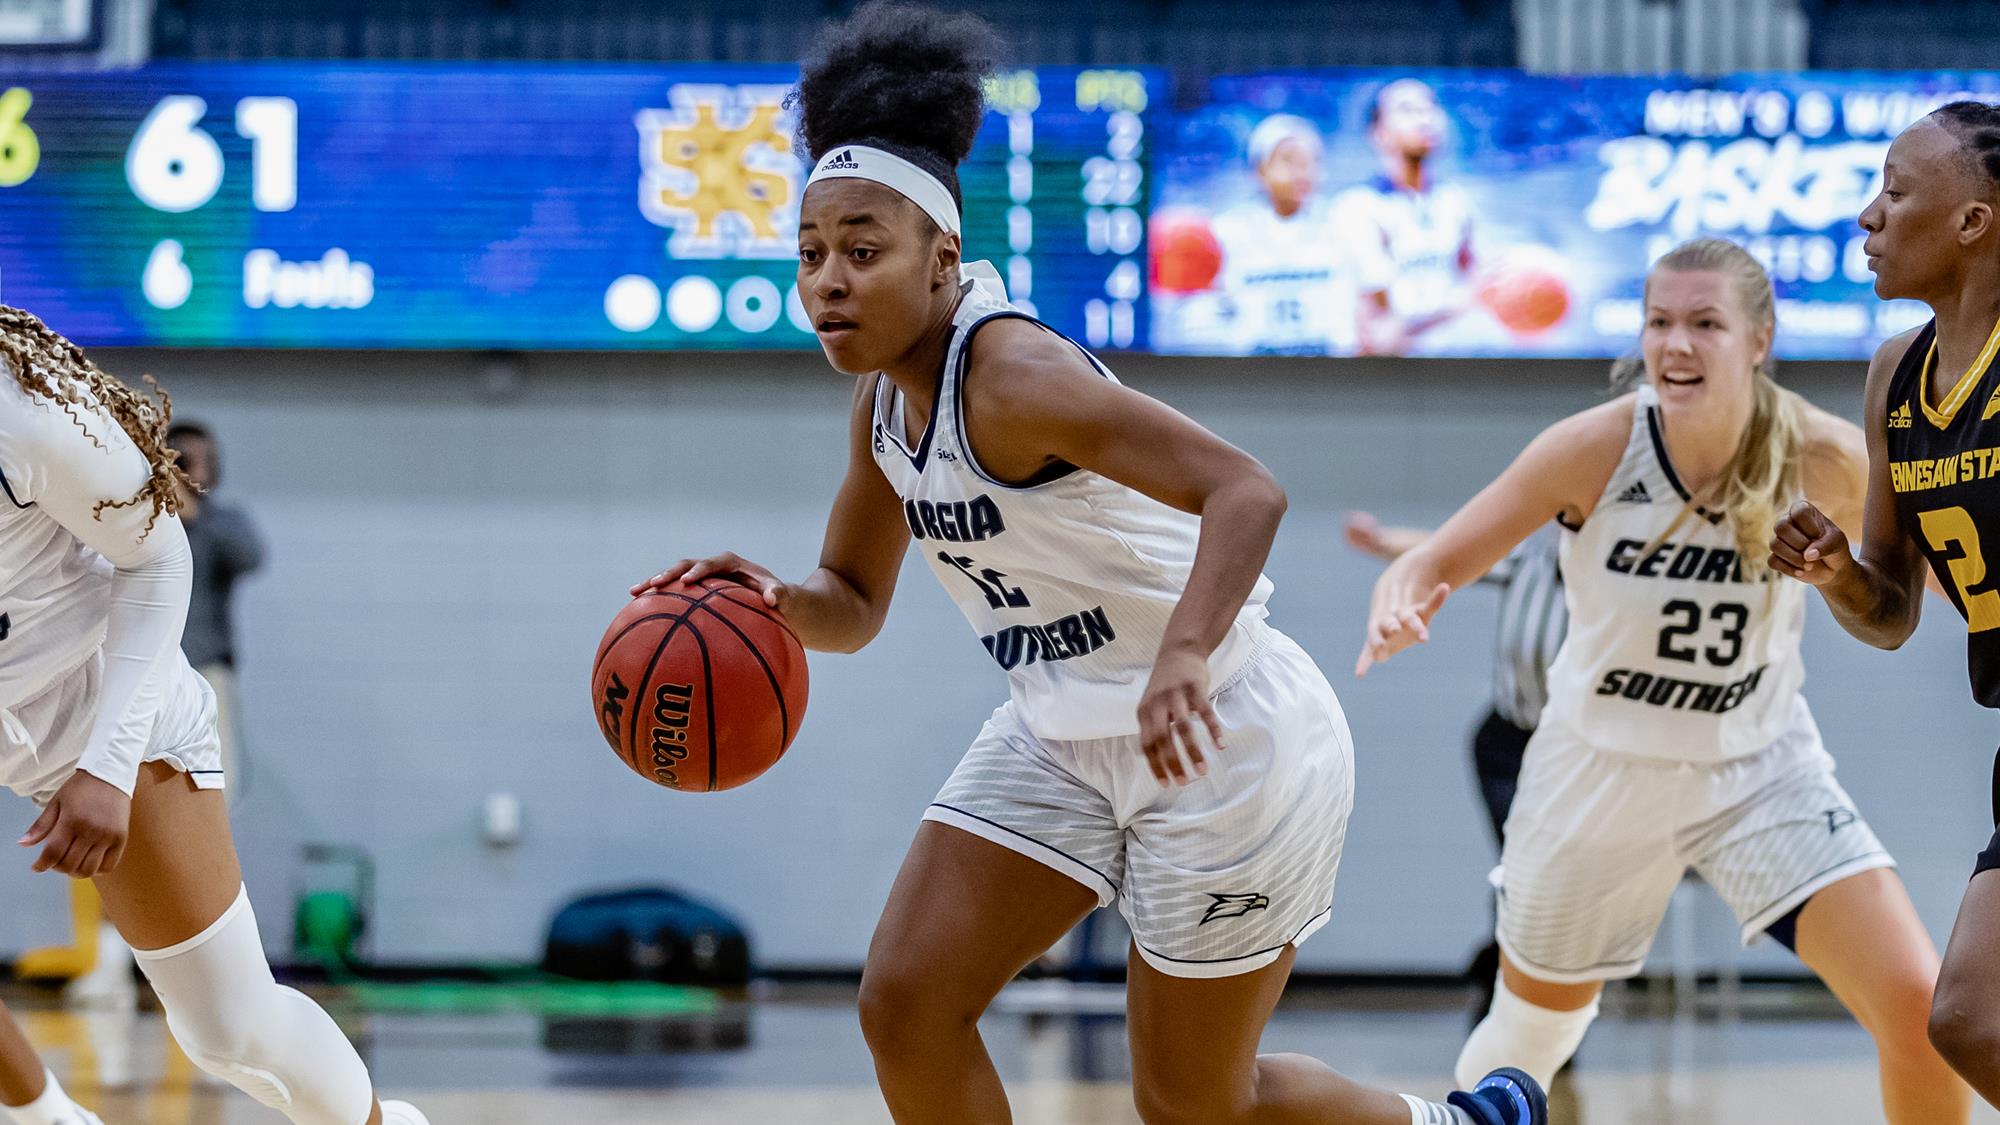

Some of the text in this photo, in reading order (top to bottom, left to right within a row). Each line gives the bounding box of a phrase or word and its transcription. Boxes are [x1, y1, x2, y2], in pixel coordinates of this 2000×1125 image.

[0, 87, 40, 187] 6
[125, 94, 299, 213] 61
[821, 161, 859, 172] adidas
[142, 238, 194, 310] 6
[1889, 446, 2000, 493] ENNESAW STA
[901, 493, 1006, 543] ORGIA
[1606, 538, 1781, 583] GEOR
[1917, 505, 2000, 634] 2
[979, 605, 1117, 672] UTHERN
[1656, 598, 1749, 667] 23
[651, 682, 694, 787] Wilso
